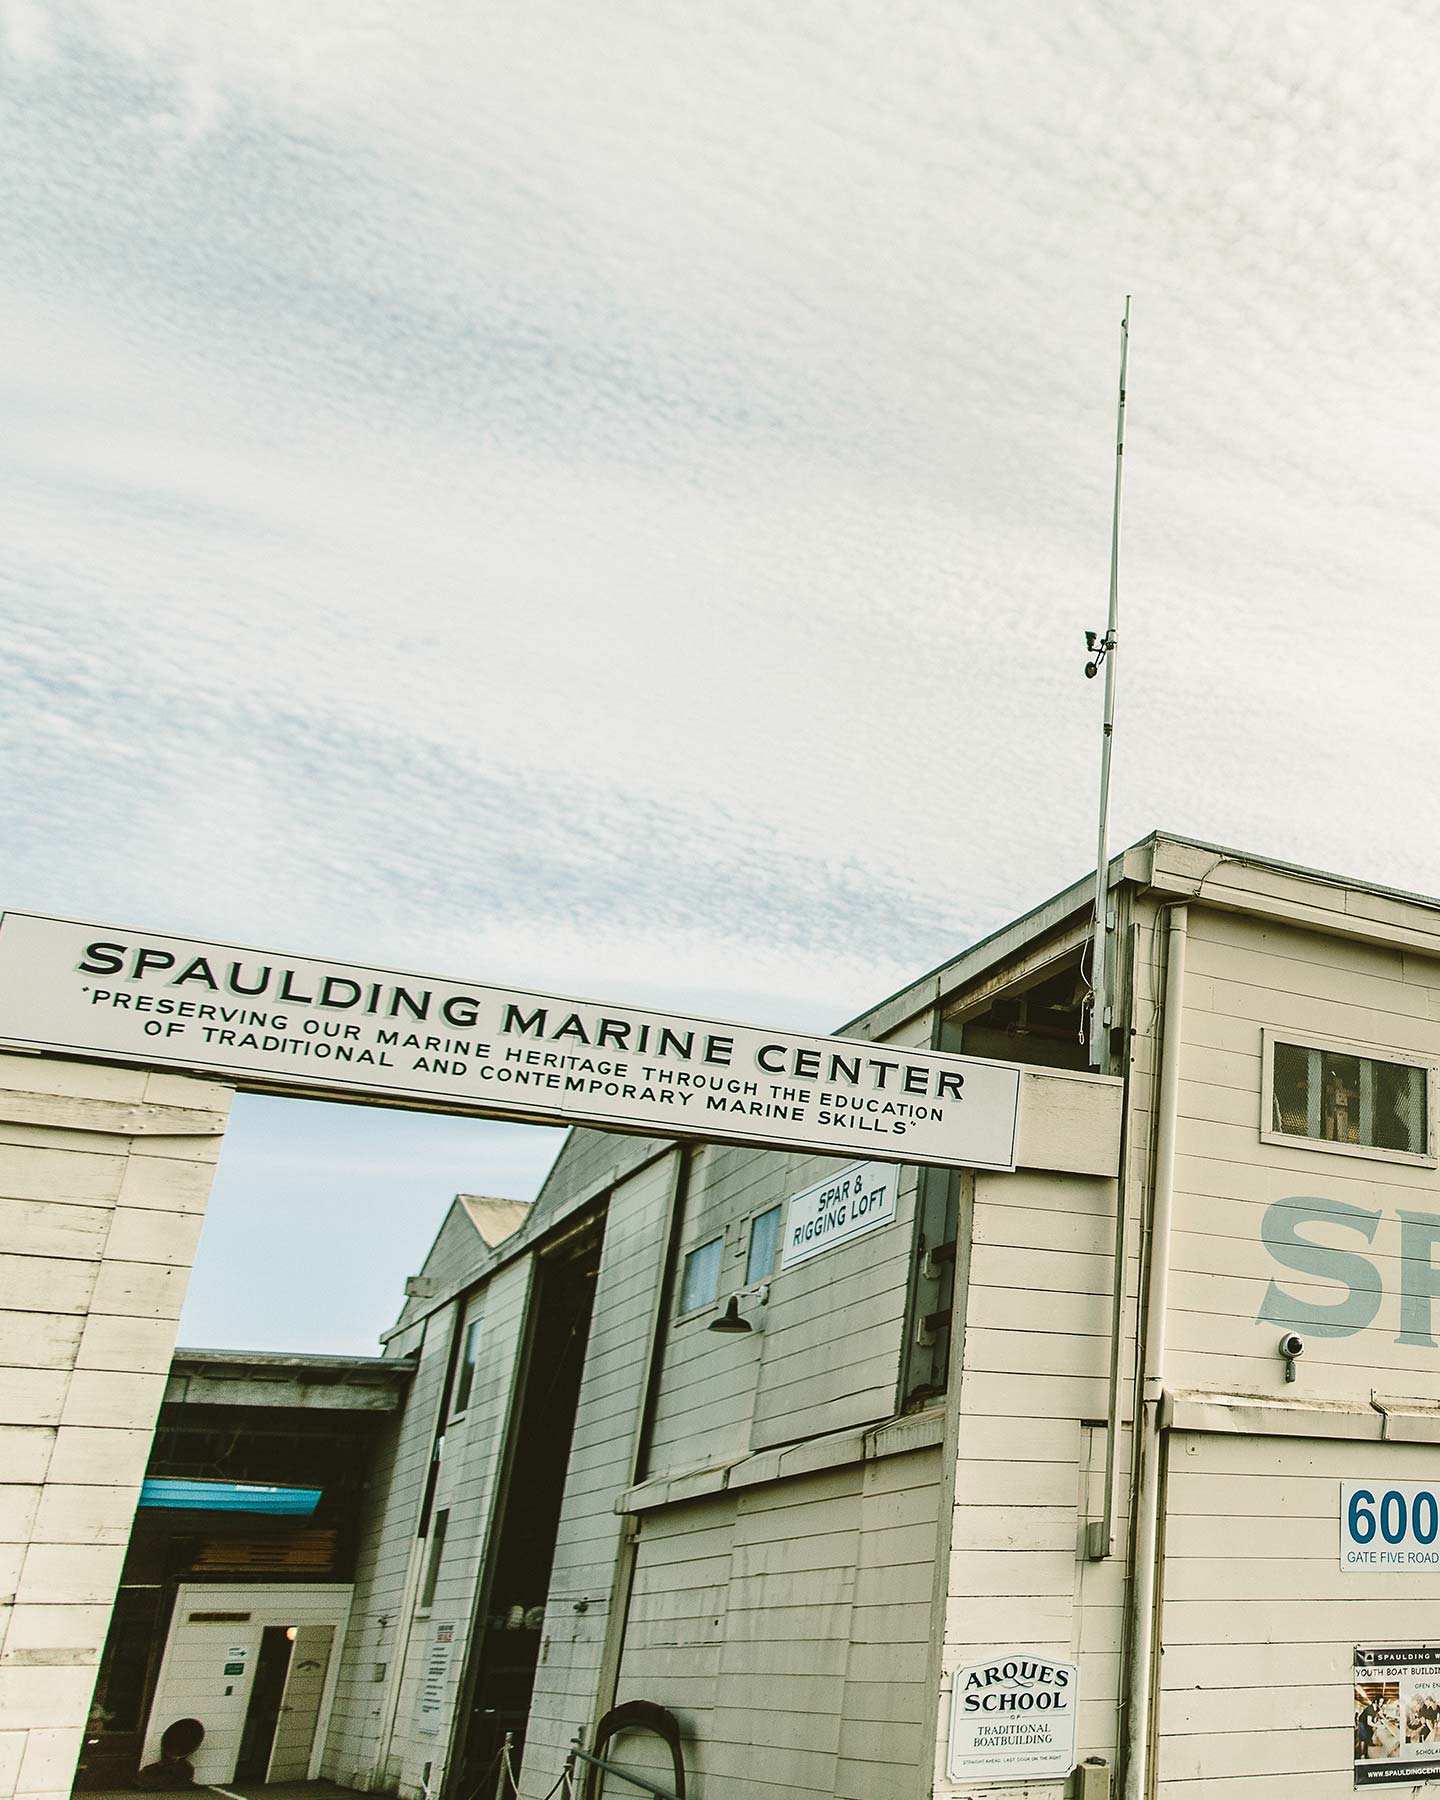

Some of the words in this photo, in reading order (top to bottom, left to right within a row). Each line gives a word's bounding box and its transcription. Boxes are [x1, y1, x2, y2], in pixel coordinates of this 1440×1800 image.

[77, 942, 481, 1028] SPAULDING
[501, 1003, 735, 1067] MARINE
[757, 1044, 966, 1101] CENTER
[144, 1020, 185, 1038] OF
[202, 1026, 394, 1067] TRADITIONAL
[412, 1056, 468, 1076] AND
[480, 1065, 694, 1106] CONTEMPORARY
[706, 1095, 805, 1122] MARINE
[303, 1019, 361, 1041] OUR
[376, 1029, 491, 1059] MARINE
[505, 1047, 629, 1078] HERITAGE
[642, 1066, 757, 1096] THROUGH
[770, 1085, 811, 1104] THE
[819, 1092, 944, 1122] EDUCATION
[818, 1180, 850, 1213] SPAR
[854, 1174, 863, 1194] &
[793, 1205, 847, 1247] RIGGING
[851, 1185, 887, 1220] LOFT
[1348, 1489, 1439, 1545] 600
[1347, 1551, 1377, 1563] GATE
[1380, 1551, 1405, 1563] FIVE
[1407, 1552, 1440, 1564] ROAD
[1355, 1668, 1383, 1677] YOUTH
[1386, 1667, 1408, 1676] BOAT
[1377, 1653, 1430, 1661] SPAULDING
[964, 1661, 1069, 1691] ARQUES
[964, 1691, 1068, 1712] SCHOOL
[973, 1734, 1053, 1747] BOATBUILDING
[977, 1723, 1051, 1736] TRADITIONAL
